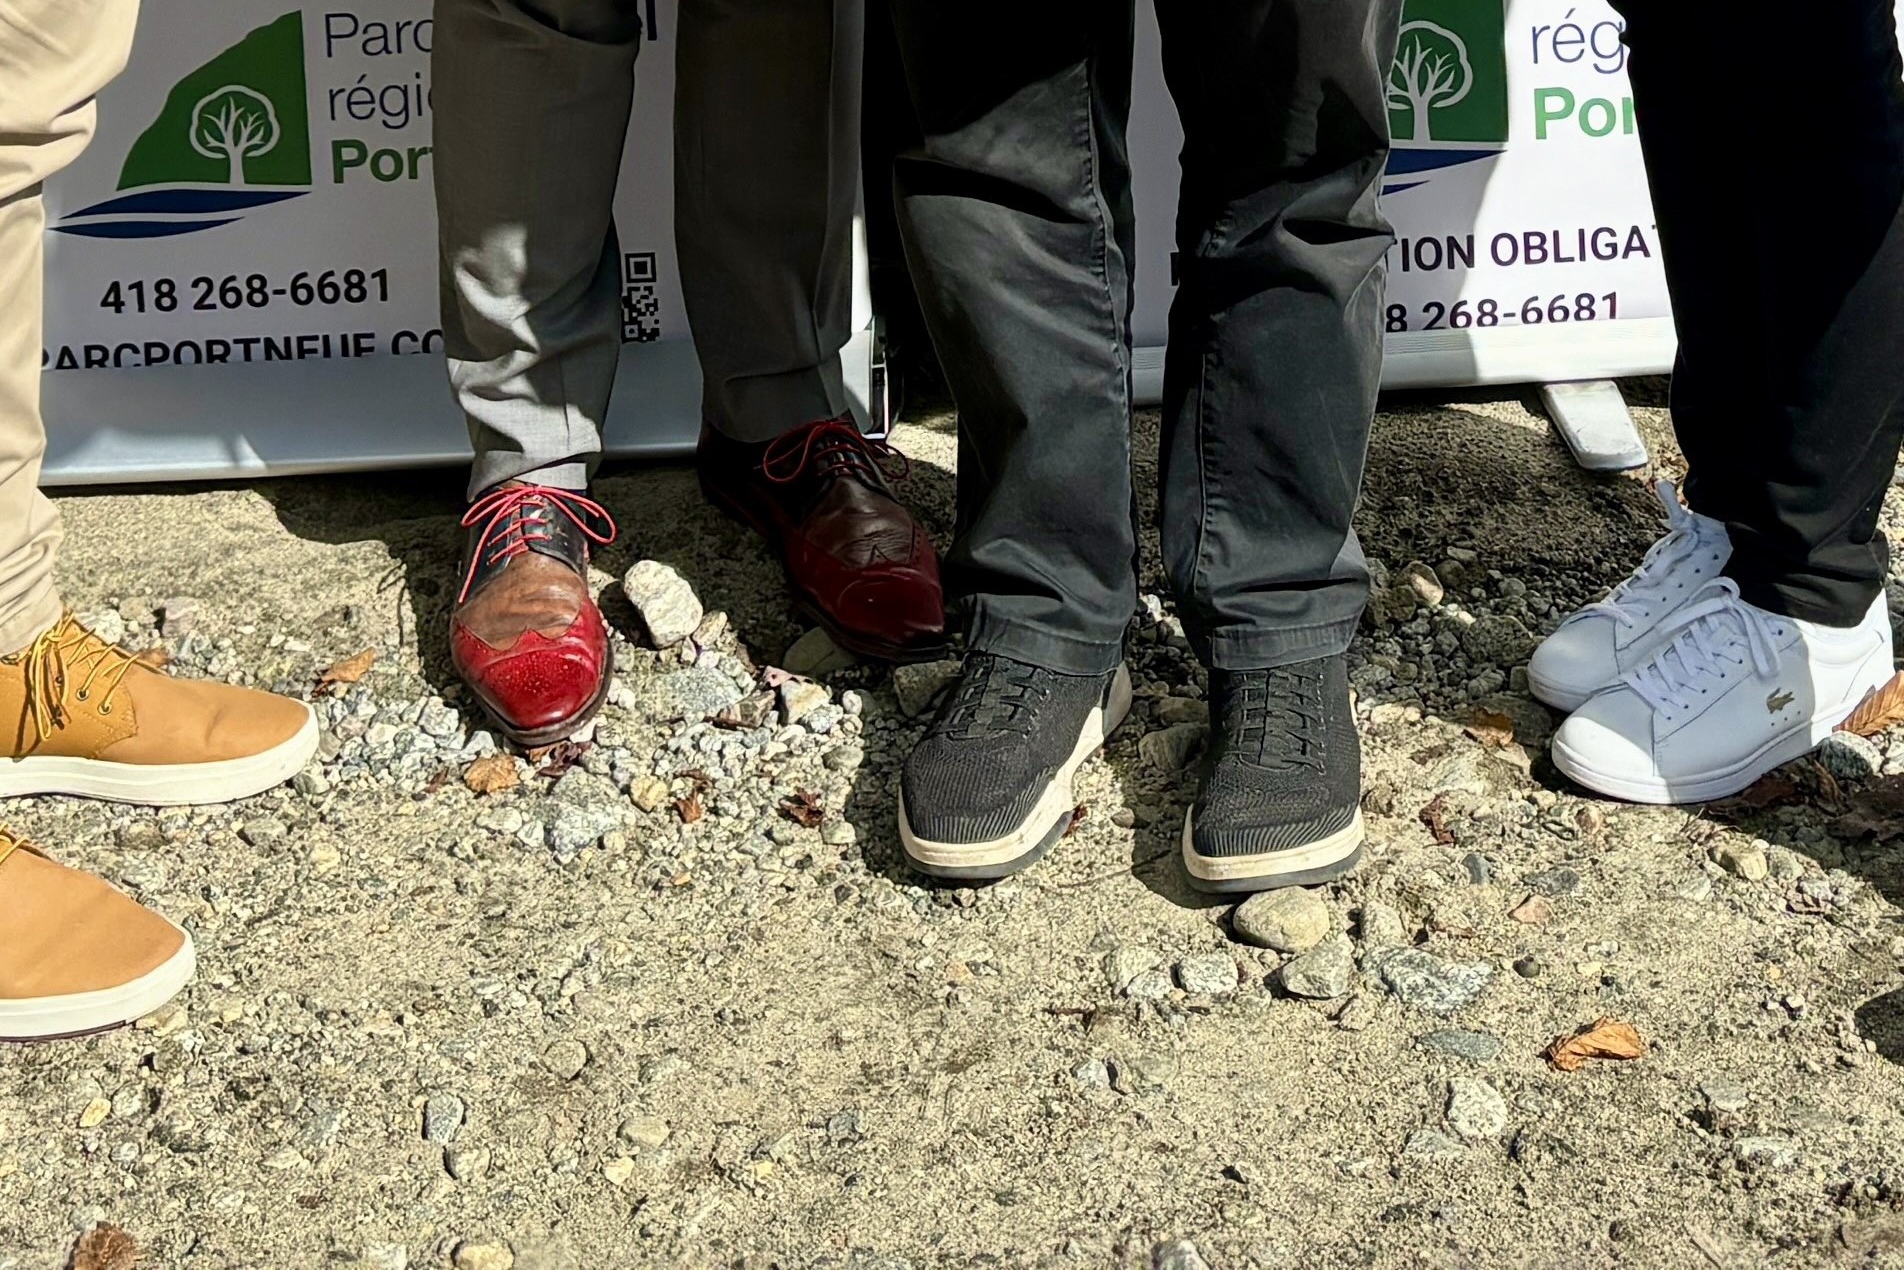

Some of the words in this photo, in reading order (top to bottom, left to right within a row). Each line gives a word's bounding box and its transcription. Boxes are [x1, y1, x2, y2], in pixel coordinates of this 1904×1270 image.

[328, 71, 433, 130] régi
[100, 278, 178, 314] 418
[191, 268, 388, 311] 268-6681
[1422, 292, 1617, 331] 268-6681
